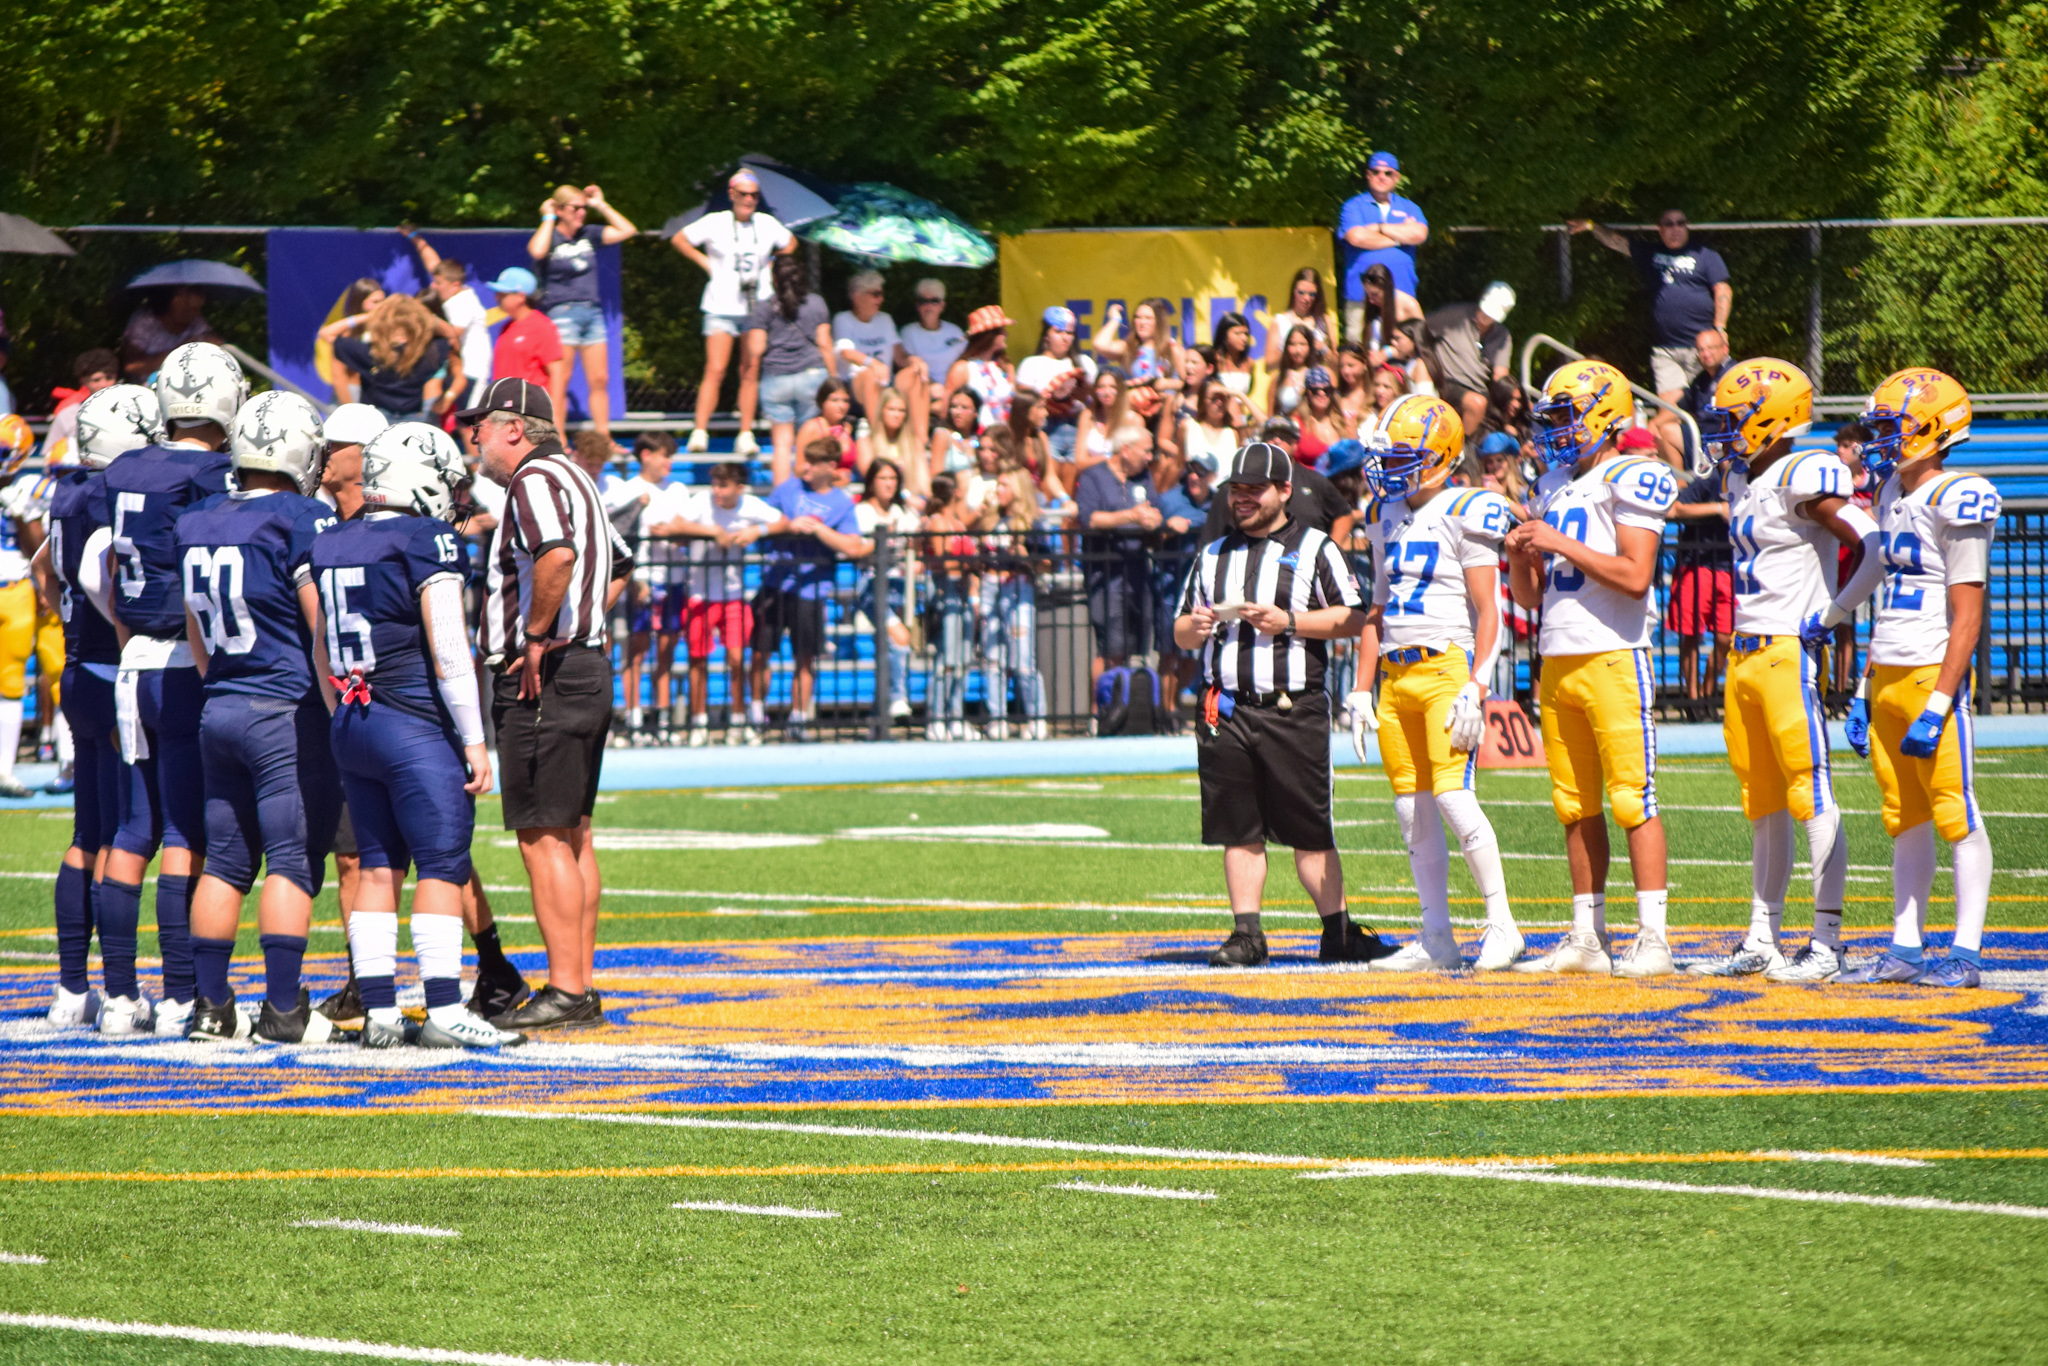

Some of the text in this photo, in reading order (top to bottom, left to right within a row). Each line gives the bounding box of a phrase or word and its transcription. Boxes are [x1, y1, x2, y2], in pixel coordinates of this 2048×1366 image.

[174, 405, 203, 415] VICIS
[1635, 472, 1672, 505] 99
[1819, 467, 1839, 493] 11
[1957, 490, 1997, 522] 22
[113, 492, 146, 598] 5
[434, 534, 458, 563] 15
[1730, 515, 1761, 595] 11
[1383, 541, 1440, 616] 27
[183, 546, 258, 656] 60
[319, 567, 377, 677] 15
[1490, 712, 1533, 756] 30
